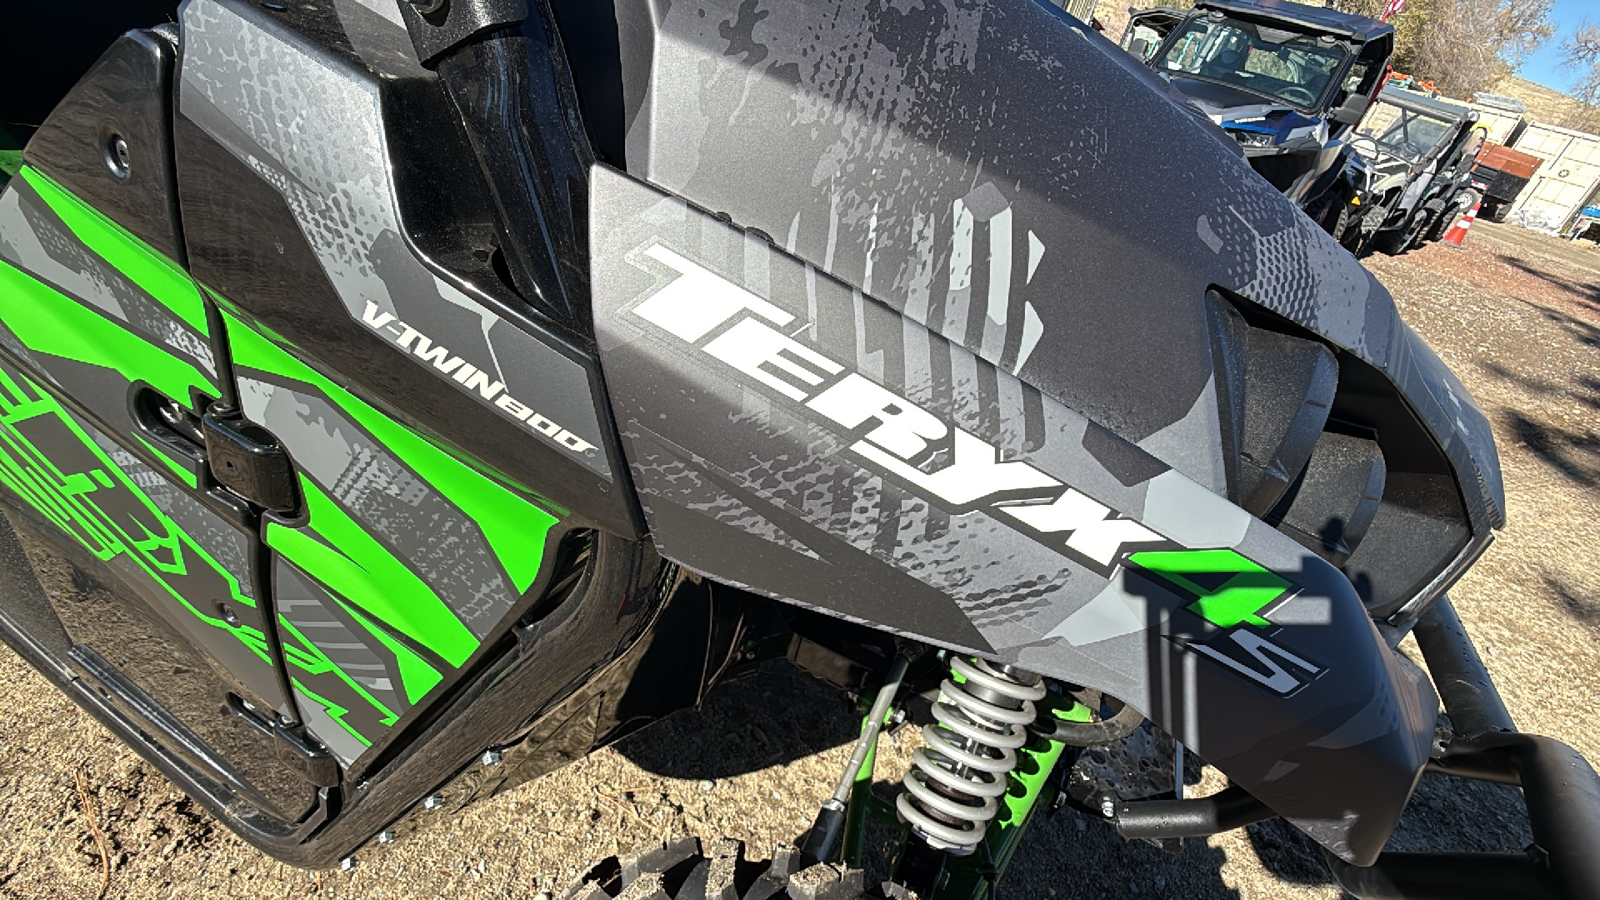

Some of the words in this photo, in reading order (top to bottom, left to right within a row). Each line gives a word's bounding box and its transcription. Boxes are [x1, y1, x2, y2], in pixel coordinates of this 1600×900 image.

[361, 300, 506, 401] V-TWIN
[495, 393, 599, 453] 800
[1186, 628, 1321, 694] S
